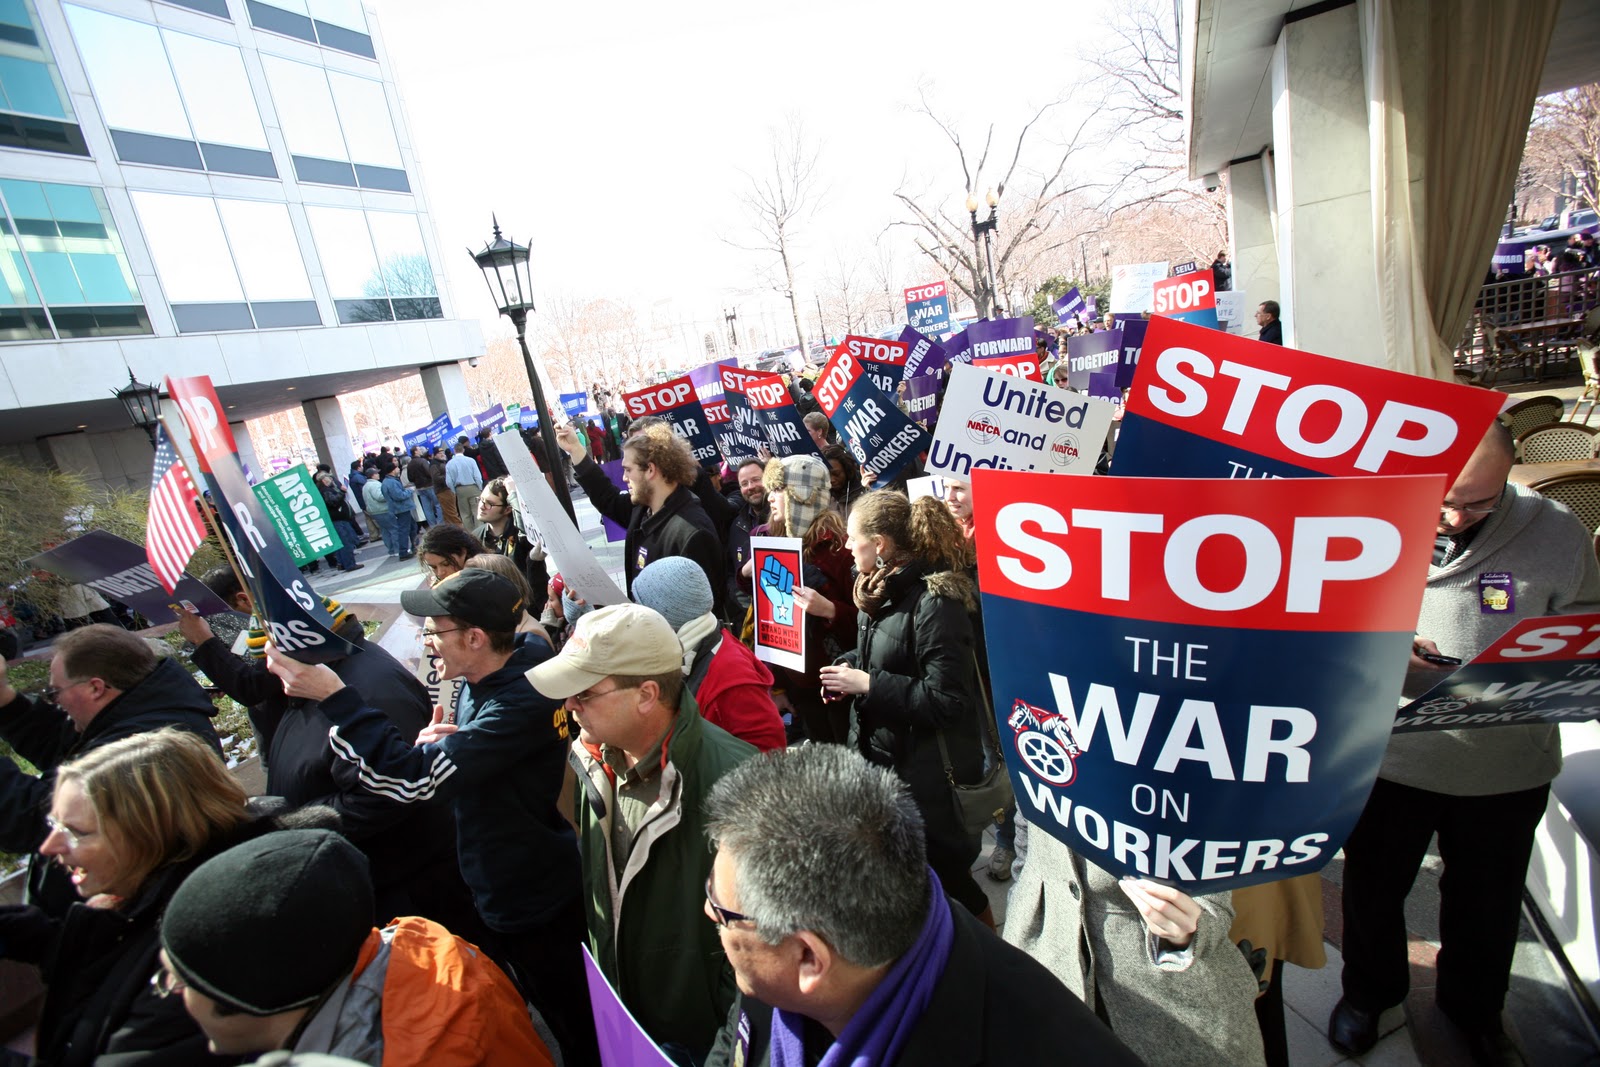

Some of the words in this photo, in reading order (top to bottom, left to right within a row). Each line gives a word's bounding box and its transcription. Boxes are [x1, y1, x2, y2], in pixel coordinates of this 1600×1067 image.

[1175, 262, 1194, 274] SEIU
[907, 284, 944, 301] STOP
[1156, 279, 1209, 312] STOP
[915, 304, 943, 319] WAR
[1057, 295, 1081, 316] FORWARD
[848, 340, 904, 362] STOP
[973, 336, 1032, 357] FORWARD
[867, 363, 879, 372] THE
[1070, 349, 1119, 373] TOGETHER
[818, 353, 854, 411] STOP
[868, 374, 893, 392] AR
[628, 382, 691, 415] STOP
[746, 382, 785, 407] STOP
[843, 397, 856, 413] THE
[903, 393, 936, 413] OGETHER
[983, 377, 1089, 430] United
[659, 412, 675, 422] THE
[704, 405, 731, 422] STO
[735, 406, 760, 427] WA
[767, 411, 778, 421] THE
[844, 398, 887, 443] WAR
[1147, 346, 1459, 474] STOP
[672, 418, 700, 438] AR
[750, 428, 760, 437] ON
[765, 422, 801, 443] WAR
[966, 419, 1001, 437] NATCA
[1003, 429, 1047, 451] and
[1051, 443, 1079, 457] NATCA
[736, 432, 769, 450] WORKE
[783, 445, 793, 455] ON
[864, 424, 921, 475] WORKERS
[869, 433, 884, 448] ON
[273, 472, 334, 553] AFSCME
[995, 501, 1402, 613] STOP
[1483, 598, 1508, 606] SEIU
[761, 623, 782, 635] STAND
[783, 628, 799, 639] WITH
[761, 632, 799, 649] WISCONSIN
[1124, 636, 1209, 681] THE
[1566, 663, 1600, 677] TH
[1481, 679, 1600, 702] WA
[1499, 700, 1546, 710] ON
[1048, 672, 1318, 783] WAR
[1392, 706, 1600, 728] WORKERS
[1131, 783, 1190, 823] ON
[1018, 770, 1330, 882] WORKERS
